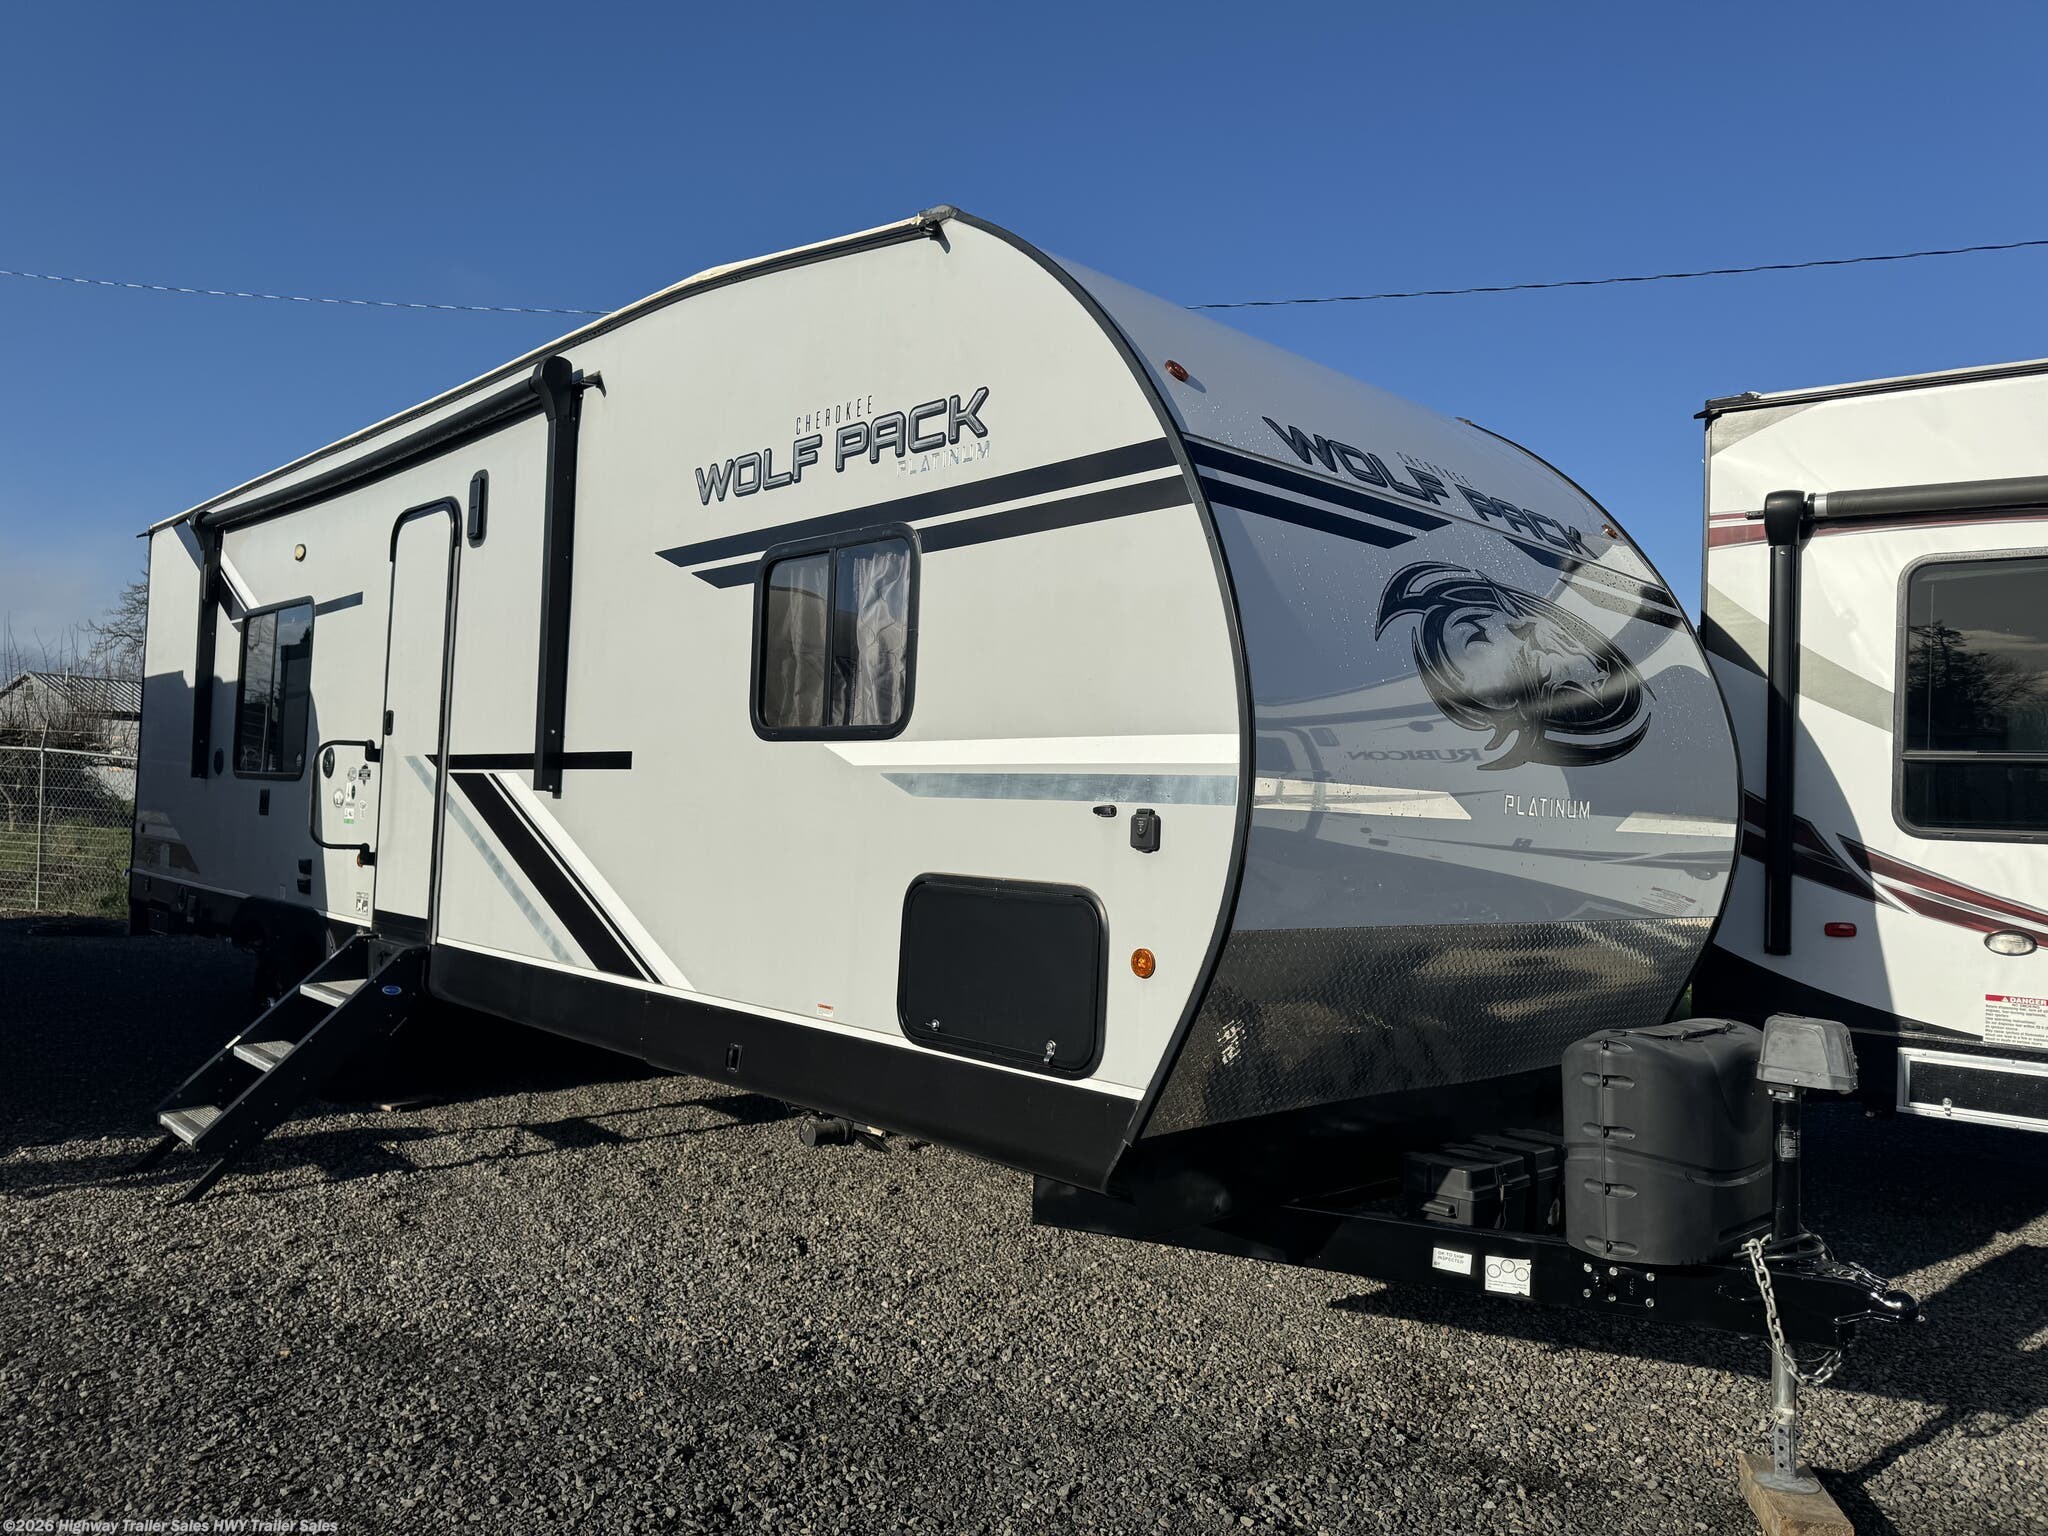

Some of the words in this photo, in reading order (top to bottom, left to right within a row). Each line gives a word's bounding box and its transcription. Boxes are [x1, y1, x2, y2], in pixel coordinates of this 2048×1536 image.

[796, 395, 873, 435] CHEROKEE
[695, 433, 823, 506] WOLF
[835, 386, 990, 473] PACK
[897, 440, 991, 478] PLATINUM
[1261, 415, 1450, 506] WOLF
[1454, 484, 1600, 561] PACK
[1504, 794, 1590, 820] PLATINUM
[2010, 997, 2046, 1006] DANGER
